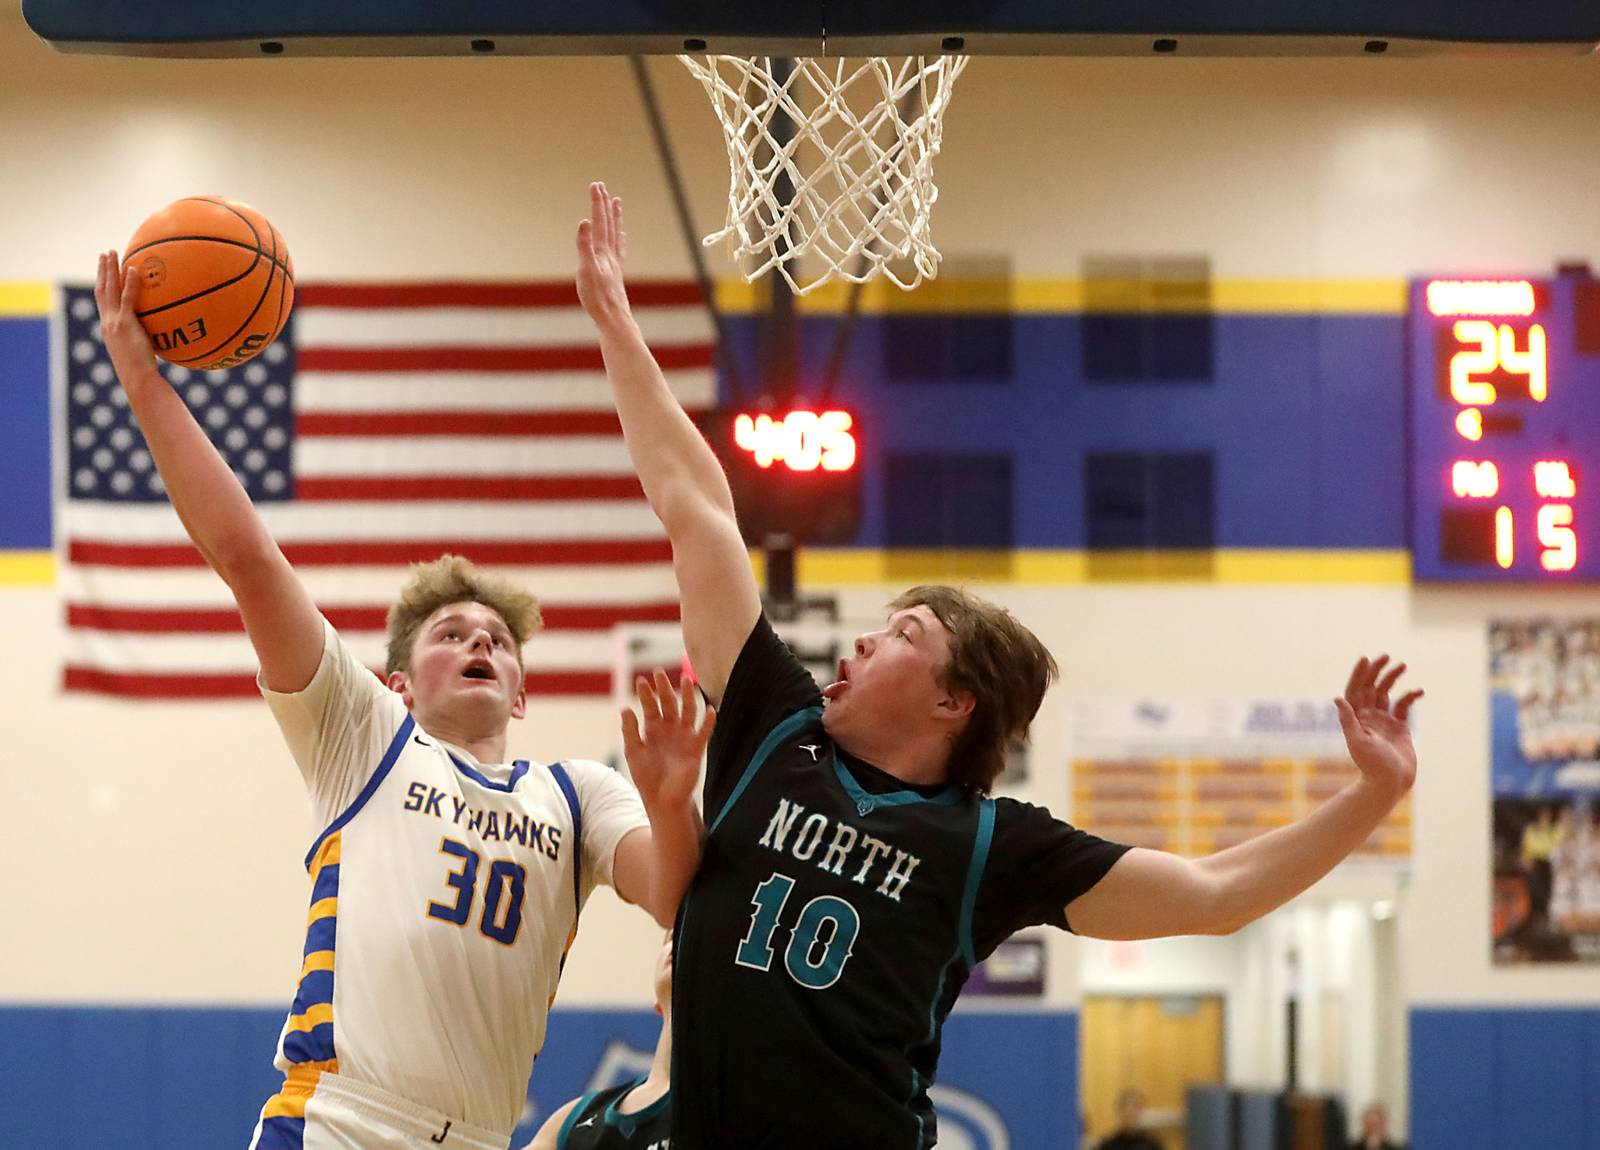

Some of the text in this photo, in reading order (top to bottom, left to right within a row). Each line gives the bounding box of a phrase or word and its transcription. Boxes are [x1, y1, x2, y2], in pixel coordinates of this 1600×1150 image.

[1450, 320, 1547, 405] 24
[735, 410, 856, 472] 4:05
[1537, 504, 1577, 571] 5
[404, 781, 562, 861] SKYHAWKS
[758, 798, 921, 903] NORTH
[426, 836, 528, 947] 30
[735, 872, 860, 990] 10
